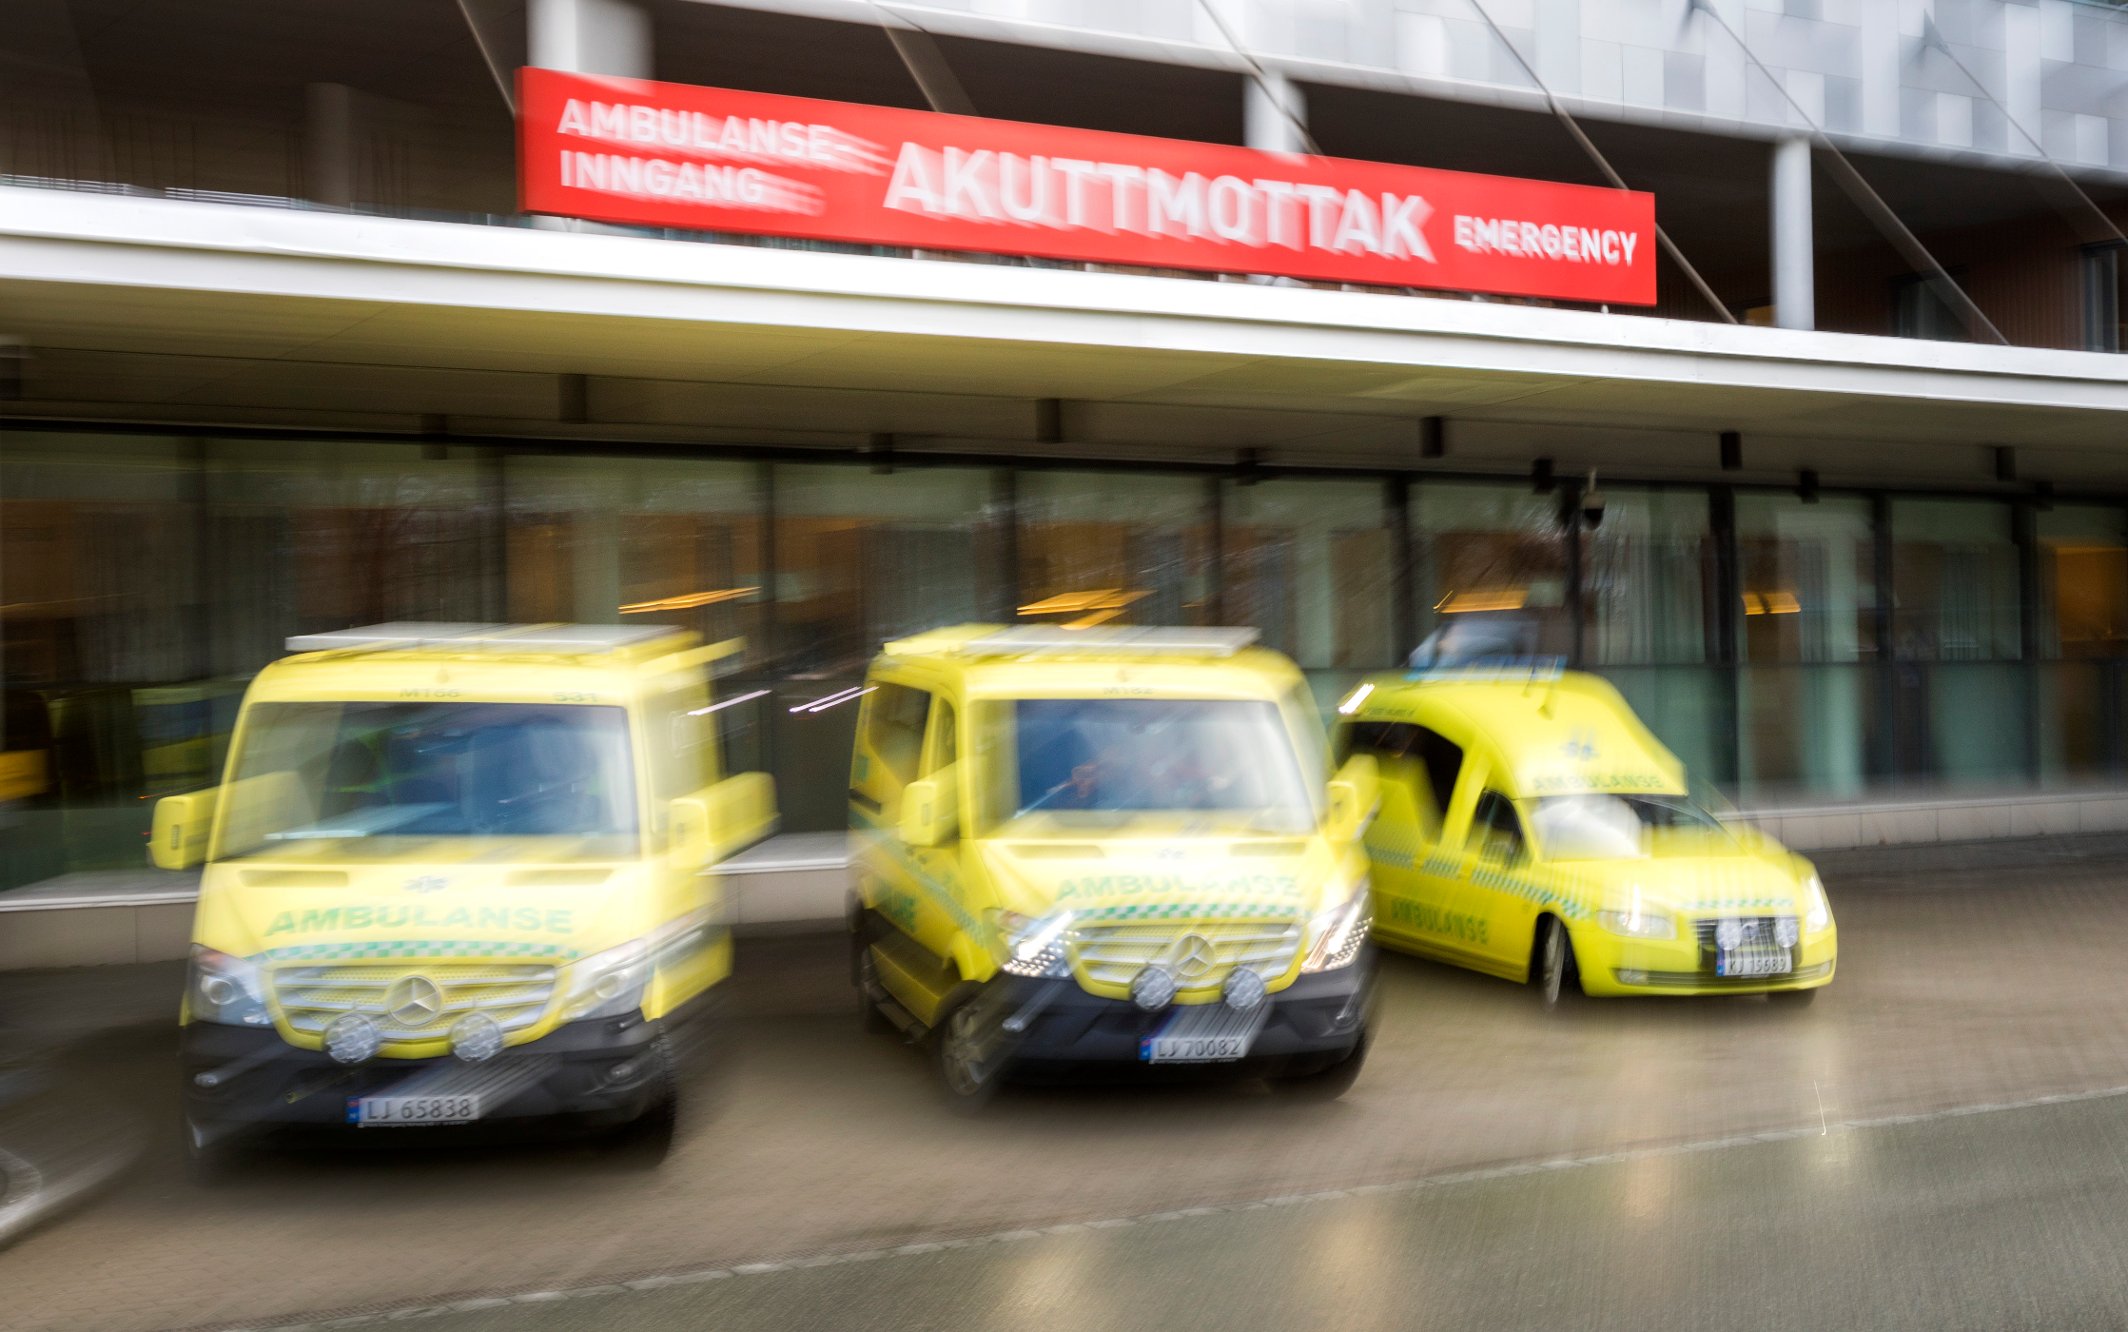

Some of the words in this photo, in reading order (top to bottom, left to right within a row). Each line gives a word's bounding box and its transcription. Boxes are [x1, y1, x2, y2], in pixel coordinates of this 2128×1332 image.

[560, 150, 775, 206] INNGANG
[883, 142, 1436, 263] AKUTTMOTTAK
[1453, 214, 1638, 267] EMERGENCY
[1055, 874, 1303, 900] AMBULANSE
[263, 905, 574, 938] AMBULANSE
[1157, 1040, 1178, 1058] LJ
[1184, 1038, 1240, 1057] 70082
[366, 1100, 391, 1120] LJ
[401, 1098, 471, 1119] 65838
